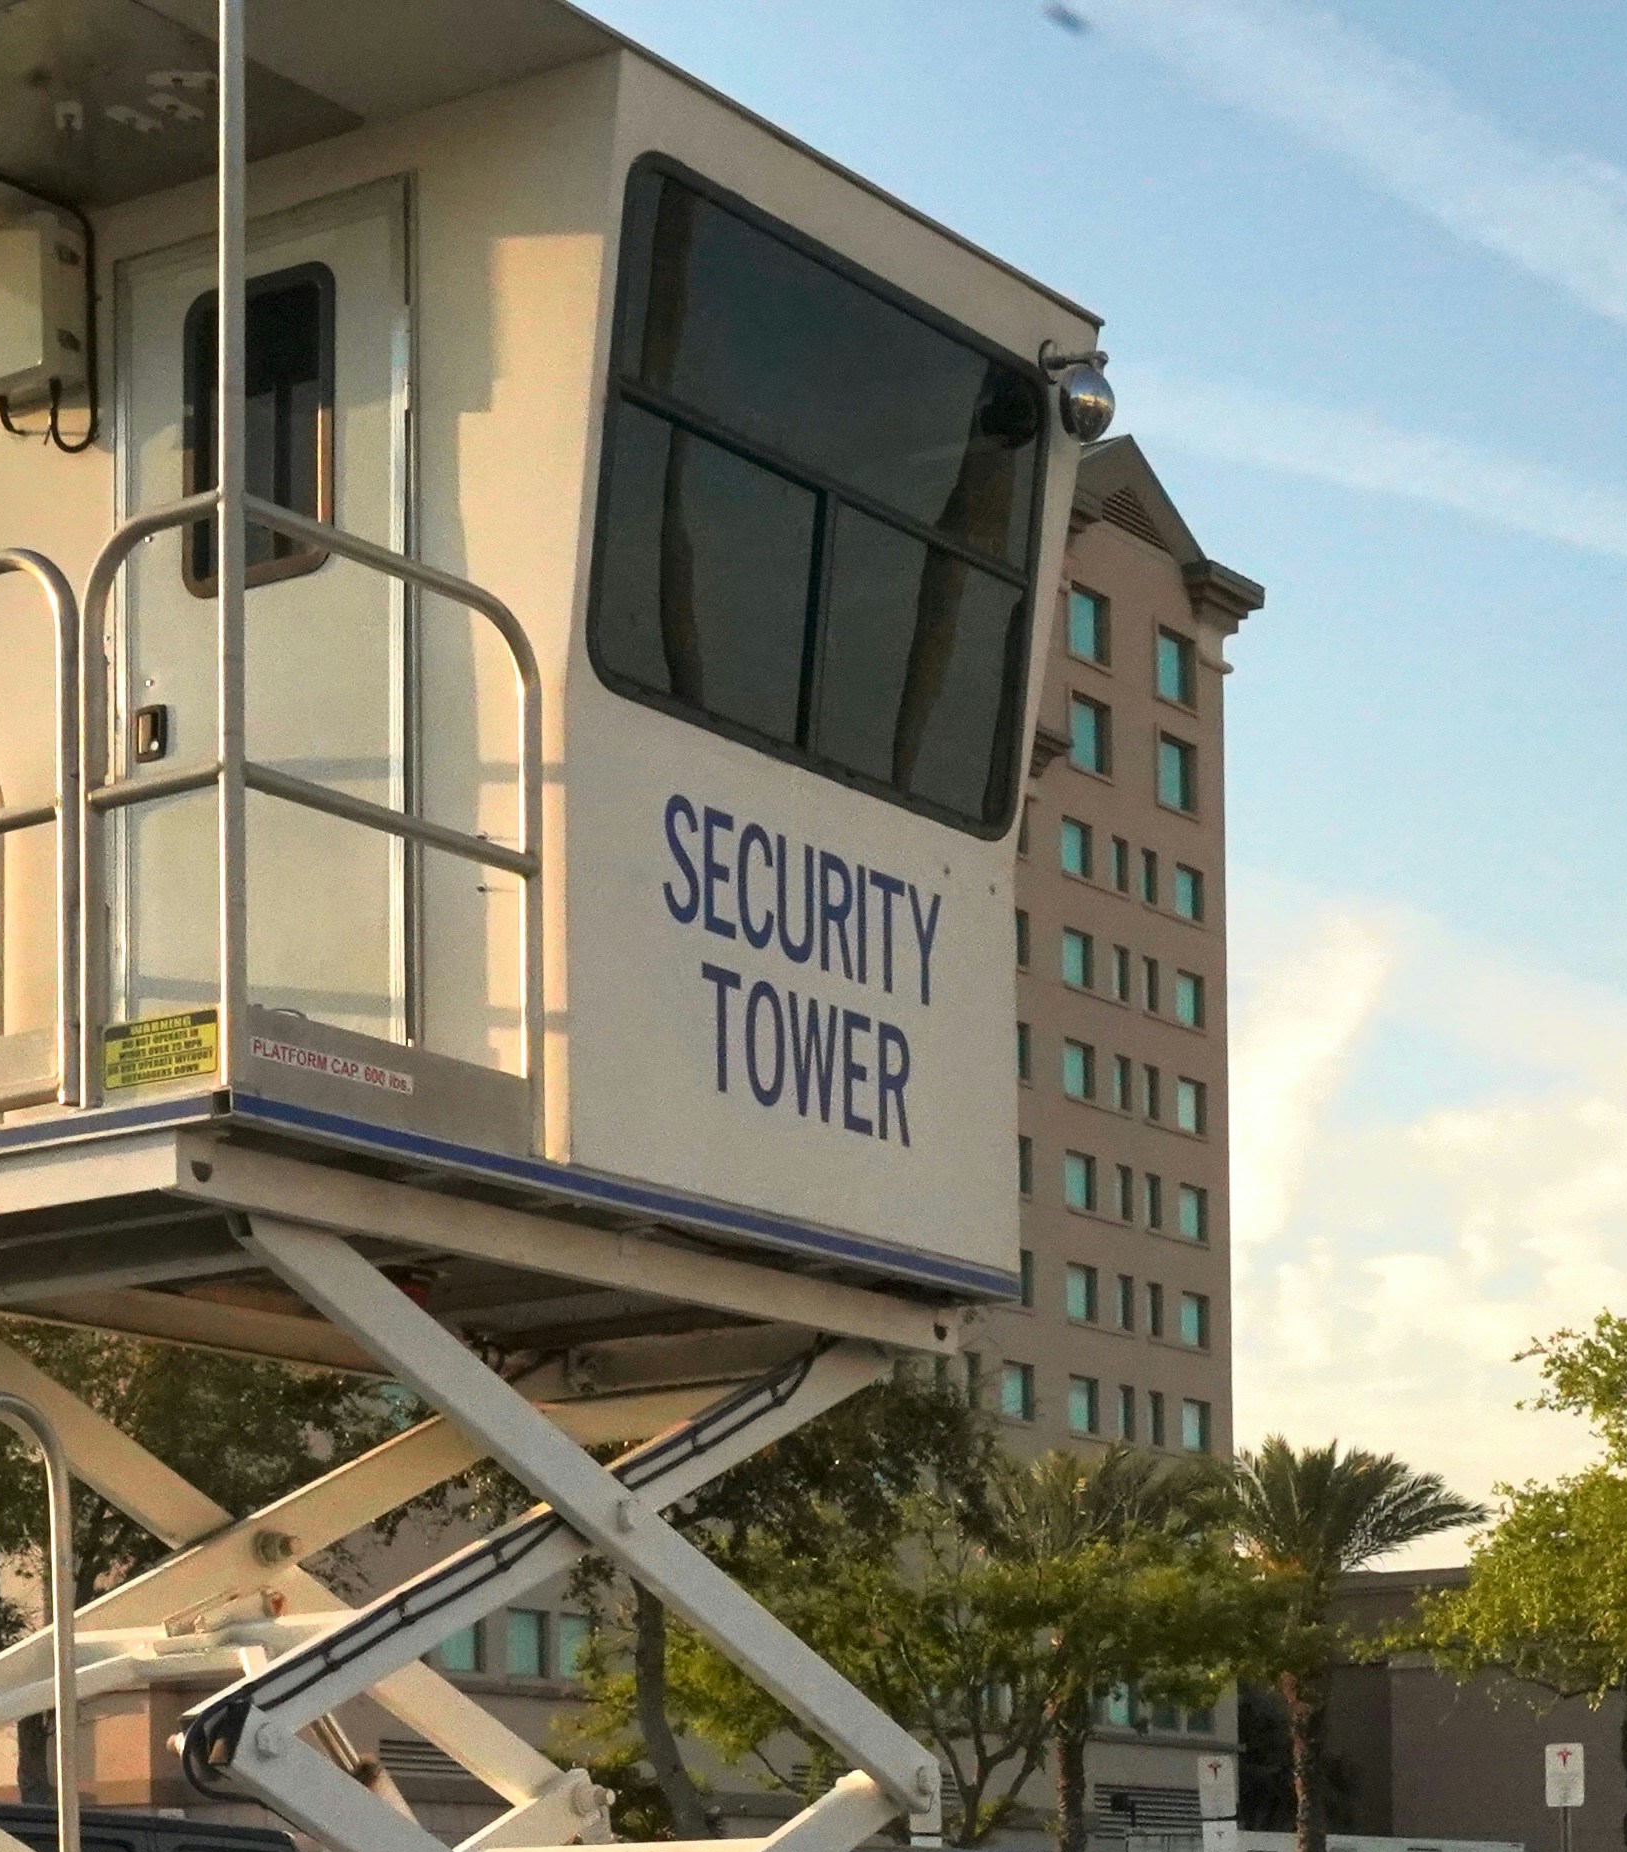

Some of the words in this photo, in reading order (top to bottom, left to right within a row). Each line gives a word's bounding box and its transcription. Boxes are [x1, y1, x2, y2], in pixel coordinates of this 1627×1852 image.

[663, 793, 941, 1006] SECURITY
[130, 1015, 191, 1036] WARNING
[152, 1030, 187, 1044] OPERATE
[253, 1039, 327, 1071] PLATFORM
[331, 1058, 359, 1077] CAP
[701, 961, 910, 1147] TOWER
